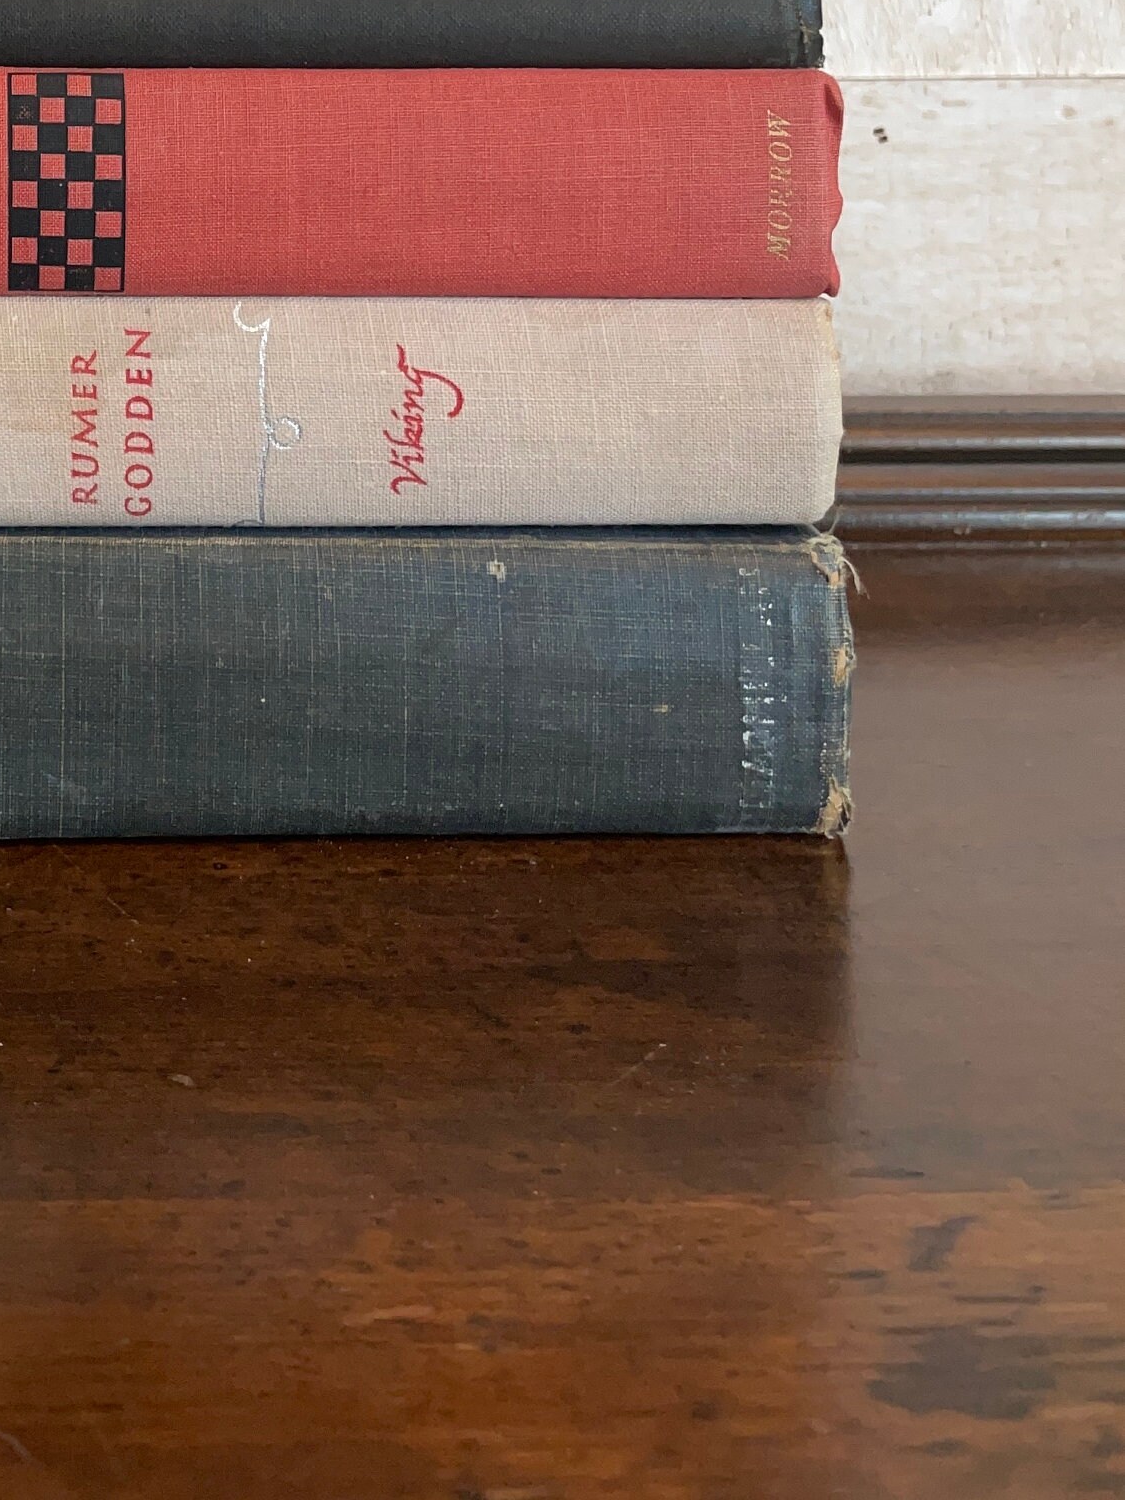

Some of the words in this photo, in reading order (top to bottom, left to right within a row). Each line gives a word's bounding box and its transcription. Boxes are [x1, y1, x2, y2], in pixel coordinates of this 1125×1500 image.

[767, 109, 793, 261] MORROW
[71, 349, 100, 505] RUMER
[123, 328, 154, 517] GODDEN
[383, 343, 465, 495] Viking
